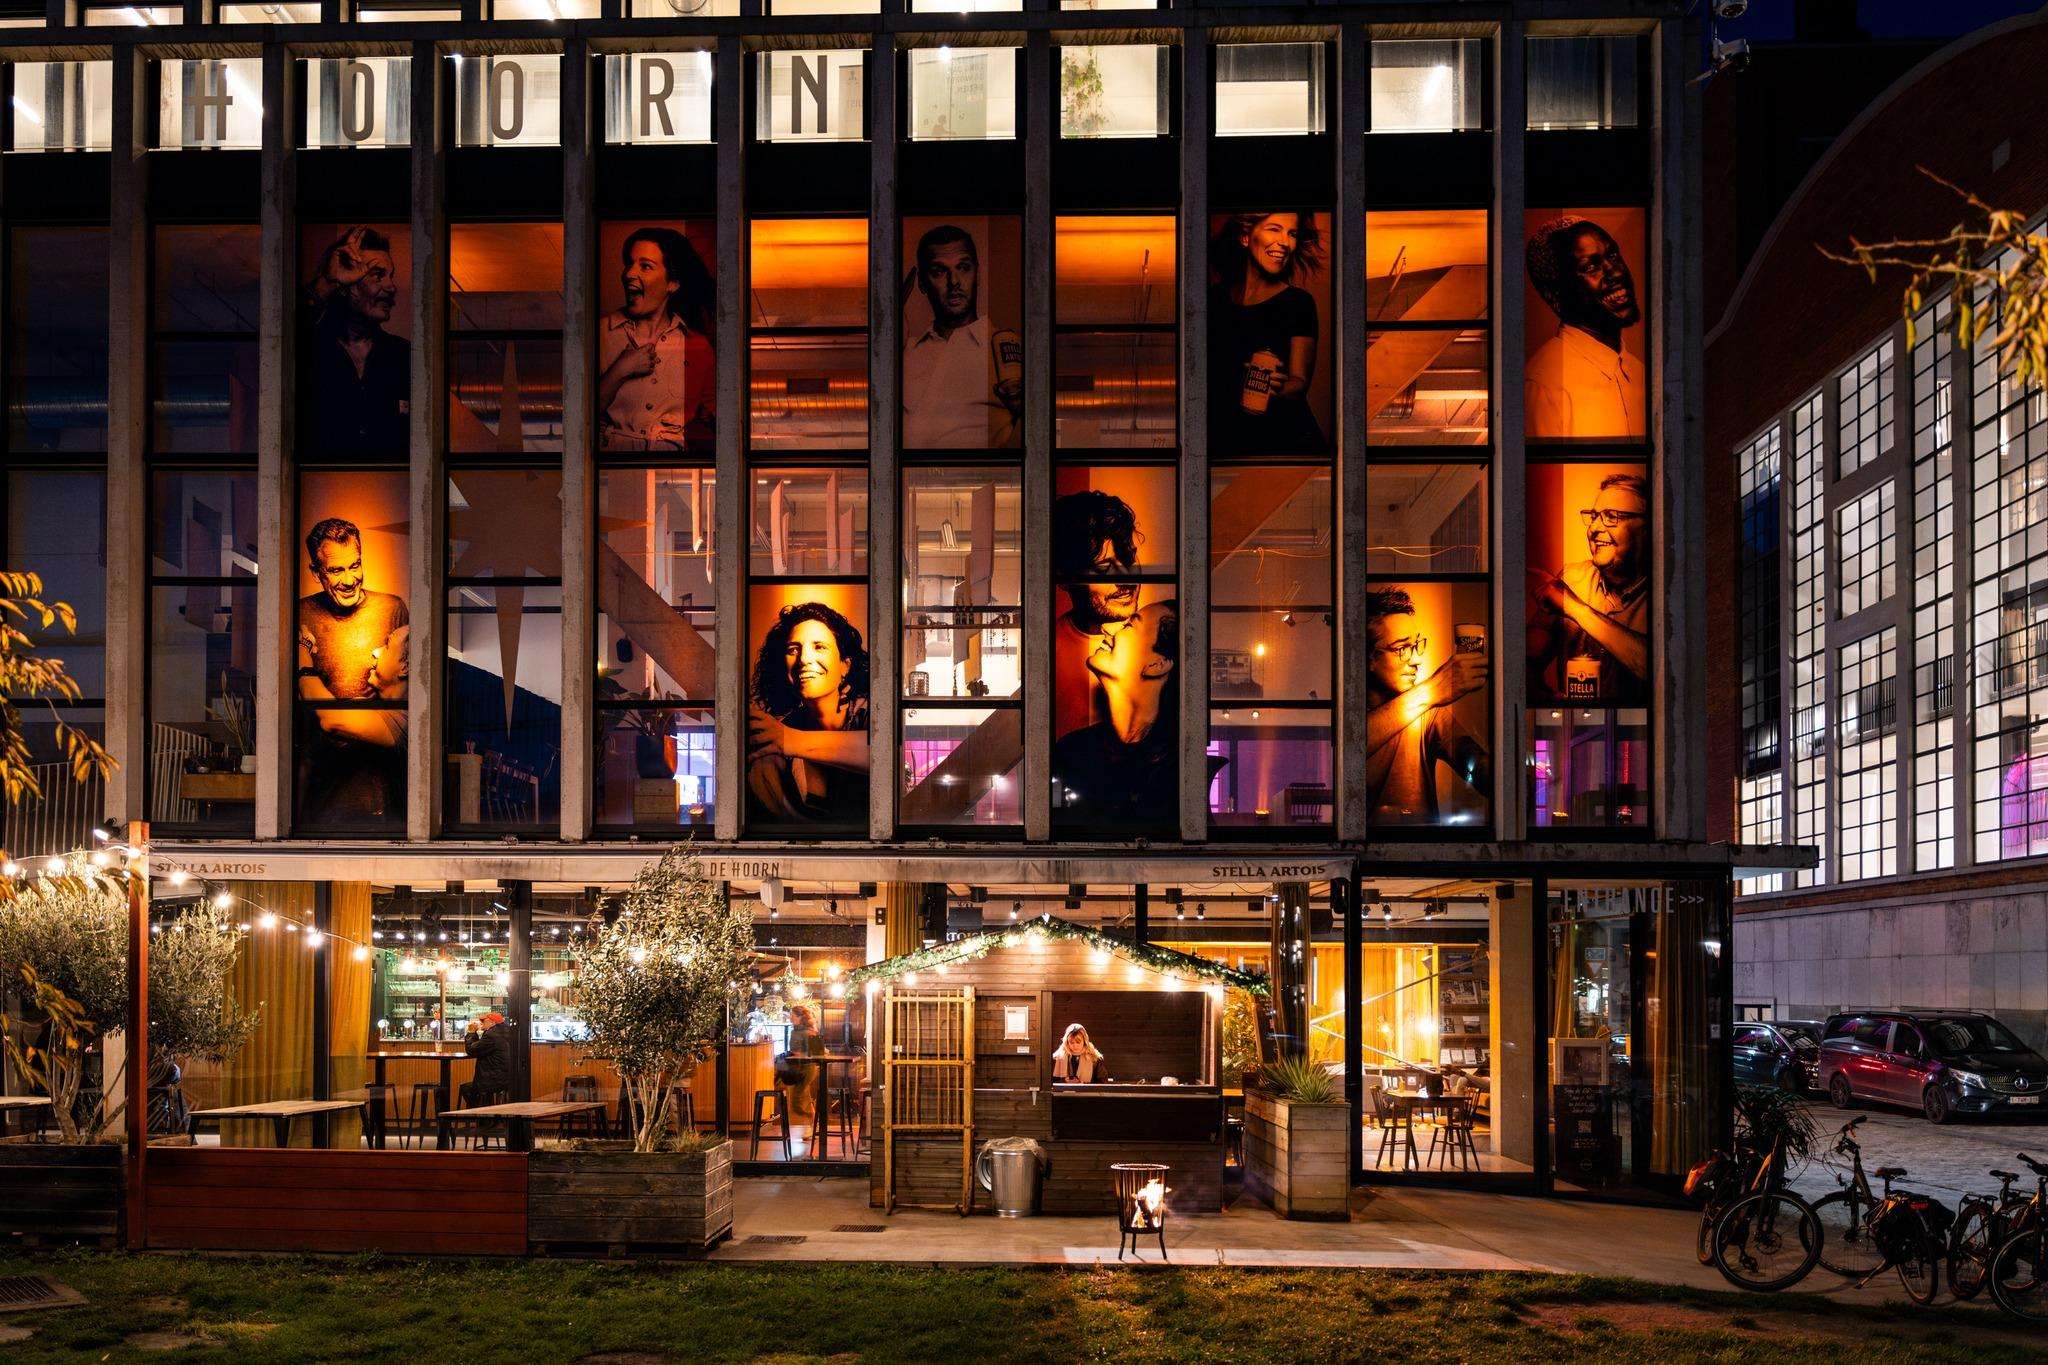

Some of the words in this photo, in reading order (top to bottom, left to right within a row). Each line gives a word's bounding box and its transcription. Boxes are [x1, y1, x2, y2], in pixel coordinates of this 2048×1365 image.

[187, 55, 828, 141] HOORN
[1569, 683, 1594, 693] STELLA
[212, 863, 266, 874] ARTOIS
[710, 862, 726, 877] DE
[732, 862, 780, 877] HOORN
[1212, 865, 1266, 877] STELLA
[1271, 865, 1326, 877] ARTOIS
[1564, 887, 1675, 914] ENTRANCE
